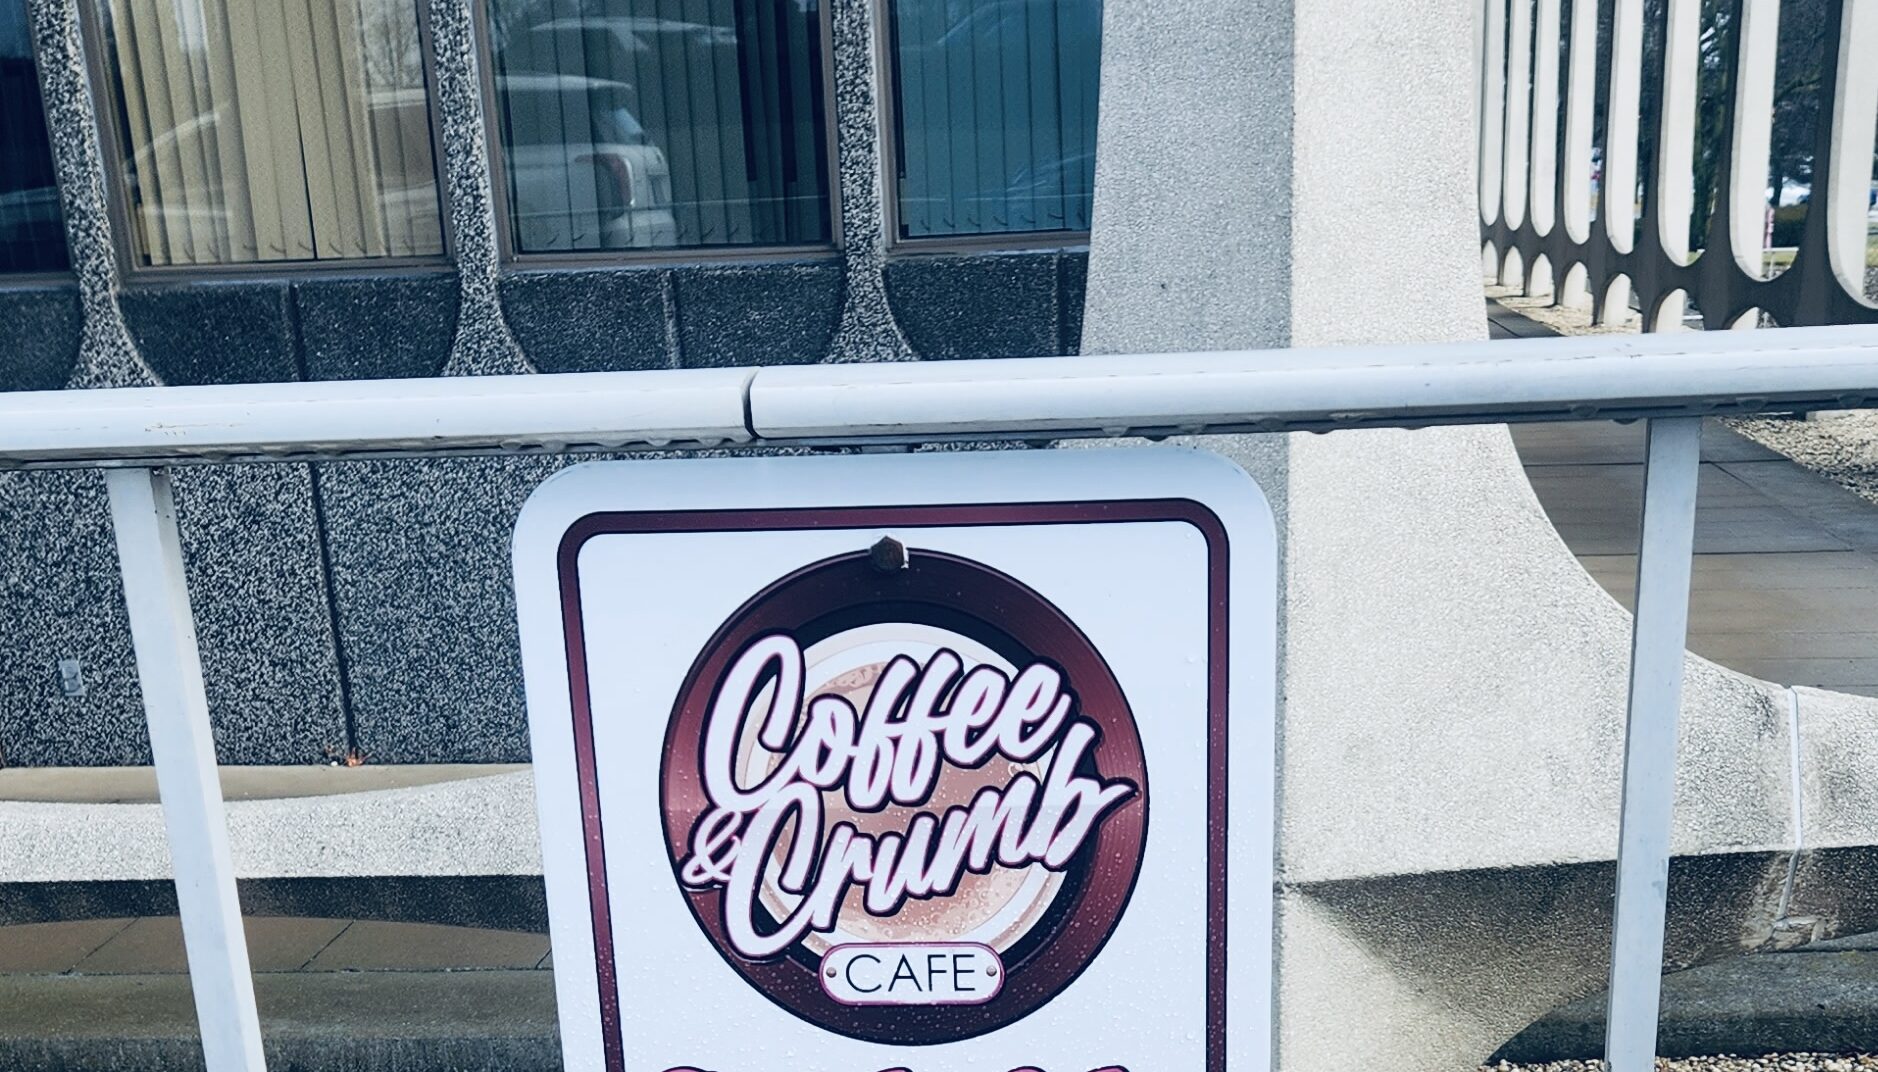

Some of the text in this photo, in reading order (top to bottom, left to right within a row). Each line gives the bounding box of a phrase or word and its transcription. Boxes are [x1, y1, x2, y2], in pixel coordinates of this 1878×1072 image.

[700, 631, 1076, 814] Coffee
[682, 721, 1138, 957] & Crumb
[845, 953, 976, 993] CAFE
